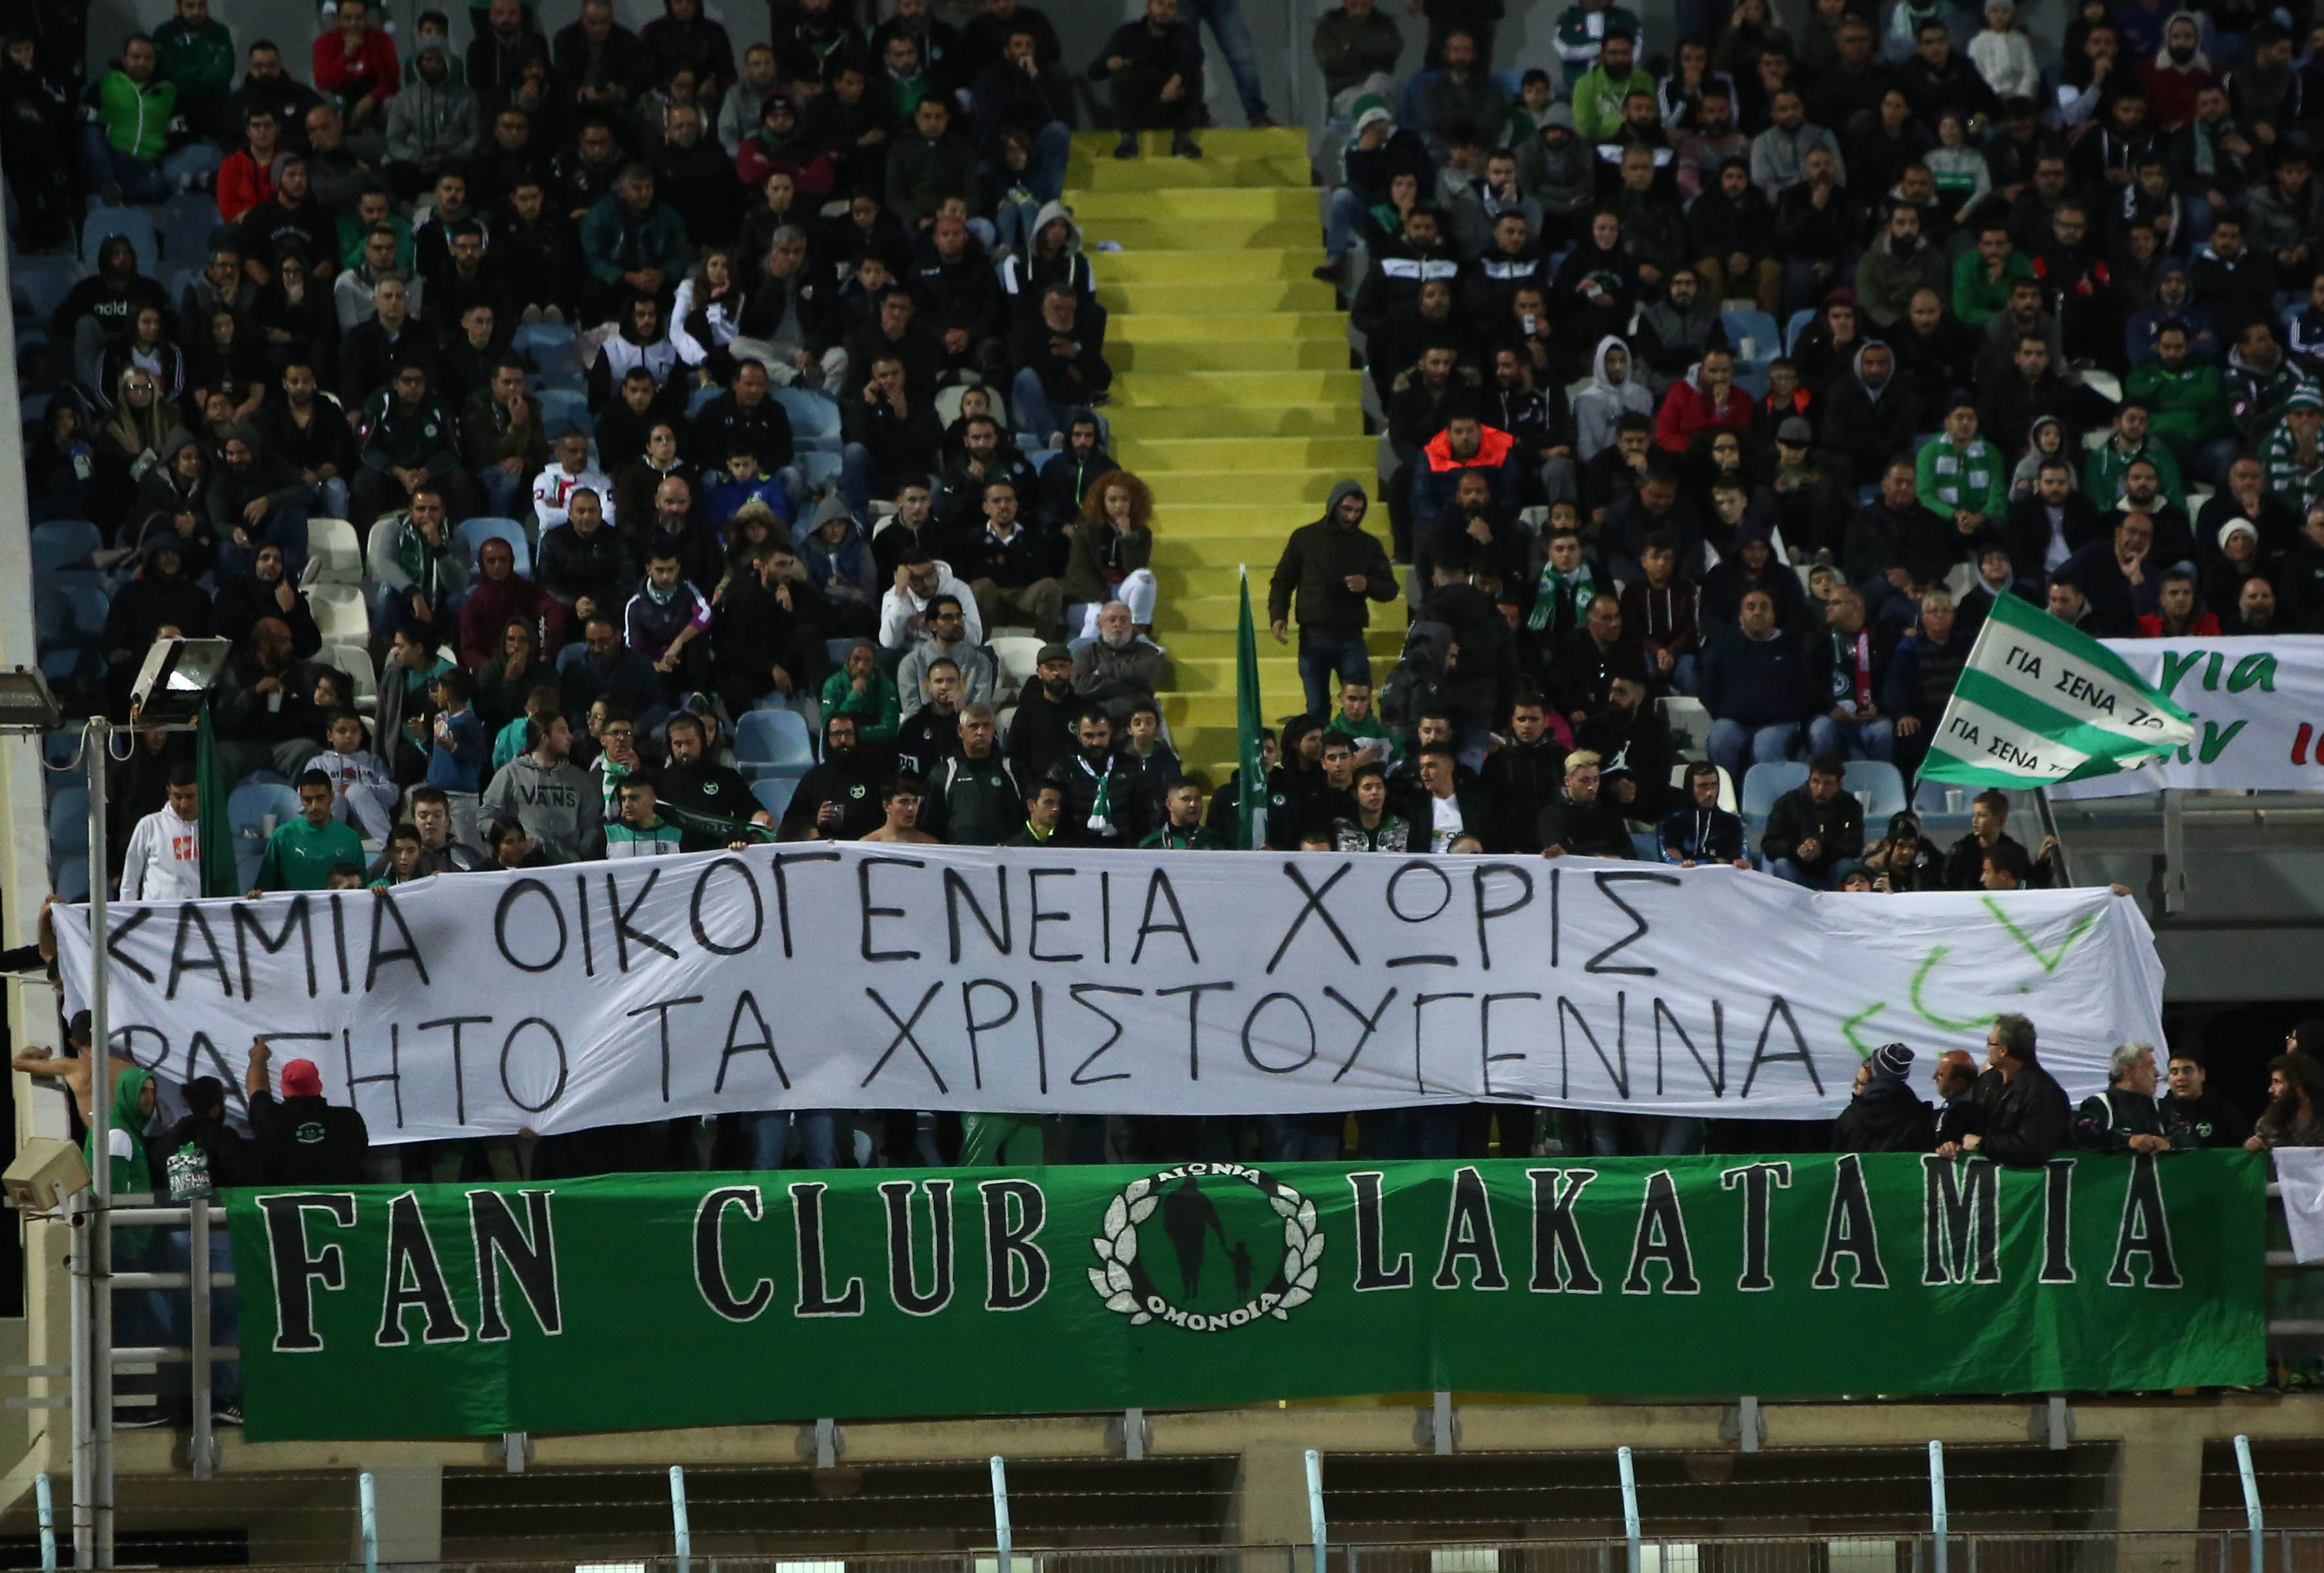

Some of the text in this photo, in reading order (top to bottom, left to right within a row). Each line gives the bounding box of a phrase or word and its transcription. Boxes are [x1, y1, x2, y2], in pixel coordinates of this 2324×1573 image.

[2005, 645, 2042, 680] ΓΙΑ
[2054, 669, 2116, 716] ΣΕΝΑ
[1949, 717, 2039, 770] ΓΙΑ ΣΕΝΑ
[519, 783, 577, 808] VANS
[493, 853, 1200, 977] ΟΙΚΟΓΕΝΕΙΑ
[1265, 859, 1682, 975] ΧΩΡΙΣ
[627, 989, 790, 1103] ΤΑ
[861, 979, 1826, 1101] ΧΡΙΣΤΟΥΓΕΝΝΑ
[255, 1153, 2183, 1353] FAN CLUB LAKATAMIA
